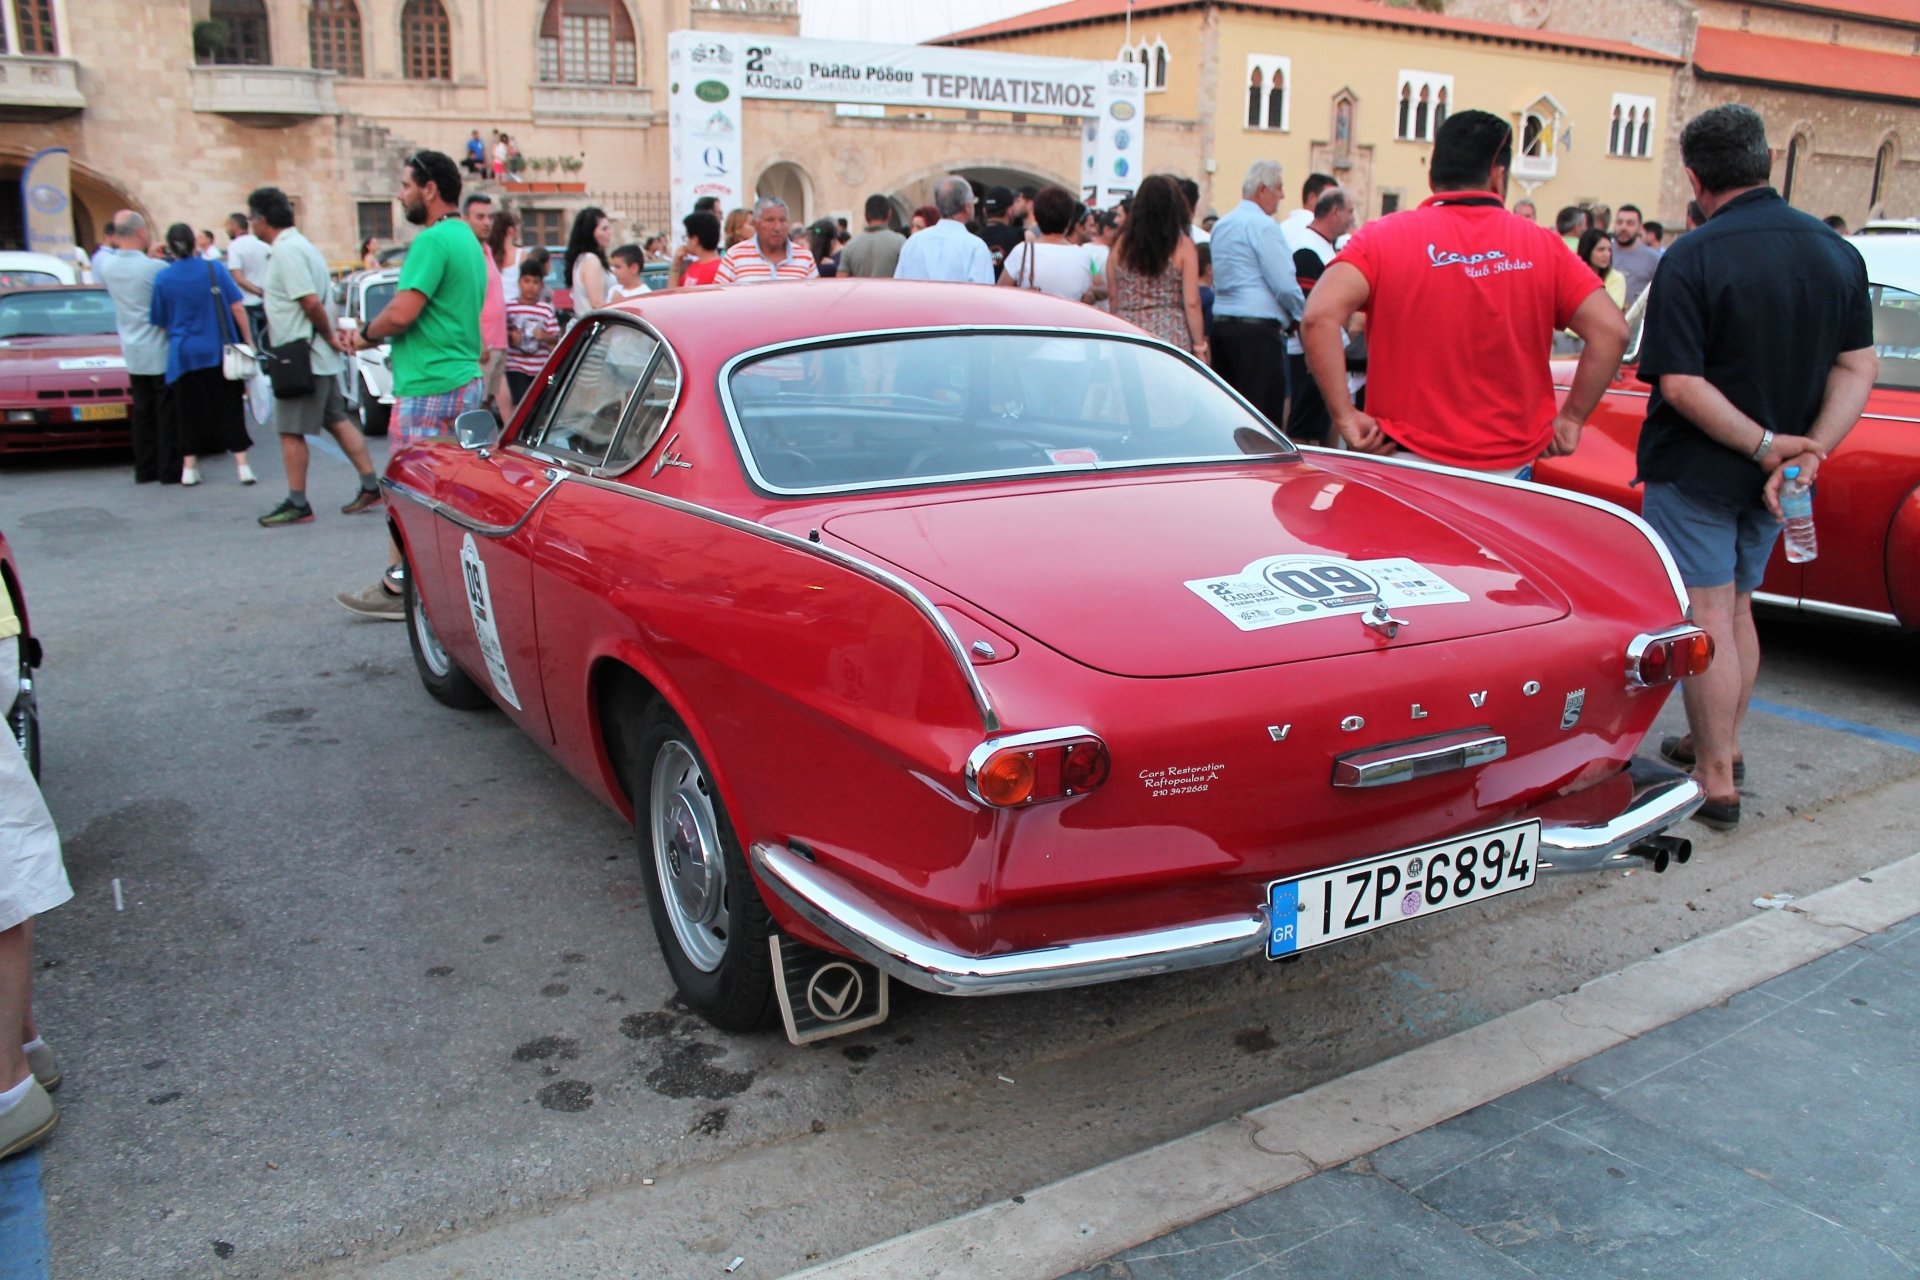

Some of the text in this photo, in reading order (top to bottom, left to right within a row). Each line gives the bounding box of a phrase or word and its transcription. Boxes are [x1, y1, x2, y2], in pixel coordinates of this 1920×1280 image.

[921, 72, 1096, 108] ΤΕΡΜΑΤΙΣΜΟΣ
[1427, 243, 1506, 267] Vespa
[1464, 264, 1490, 278] Club
[1271, 566, 1373, 599] 09
[1267, 680, 1541, 742] VOLVO
[1138, 763, 1225, 779] Cars Restoration
[1144, 774, 1205, 788] Raftopoulos
[1152, 784, 1209, 797] 210 3472662
[1322, 832, 1530, 935] IZP-6894
[1273, 924, 1294, 943] GR
